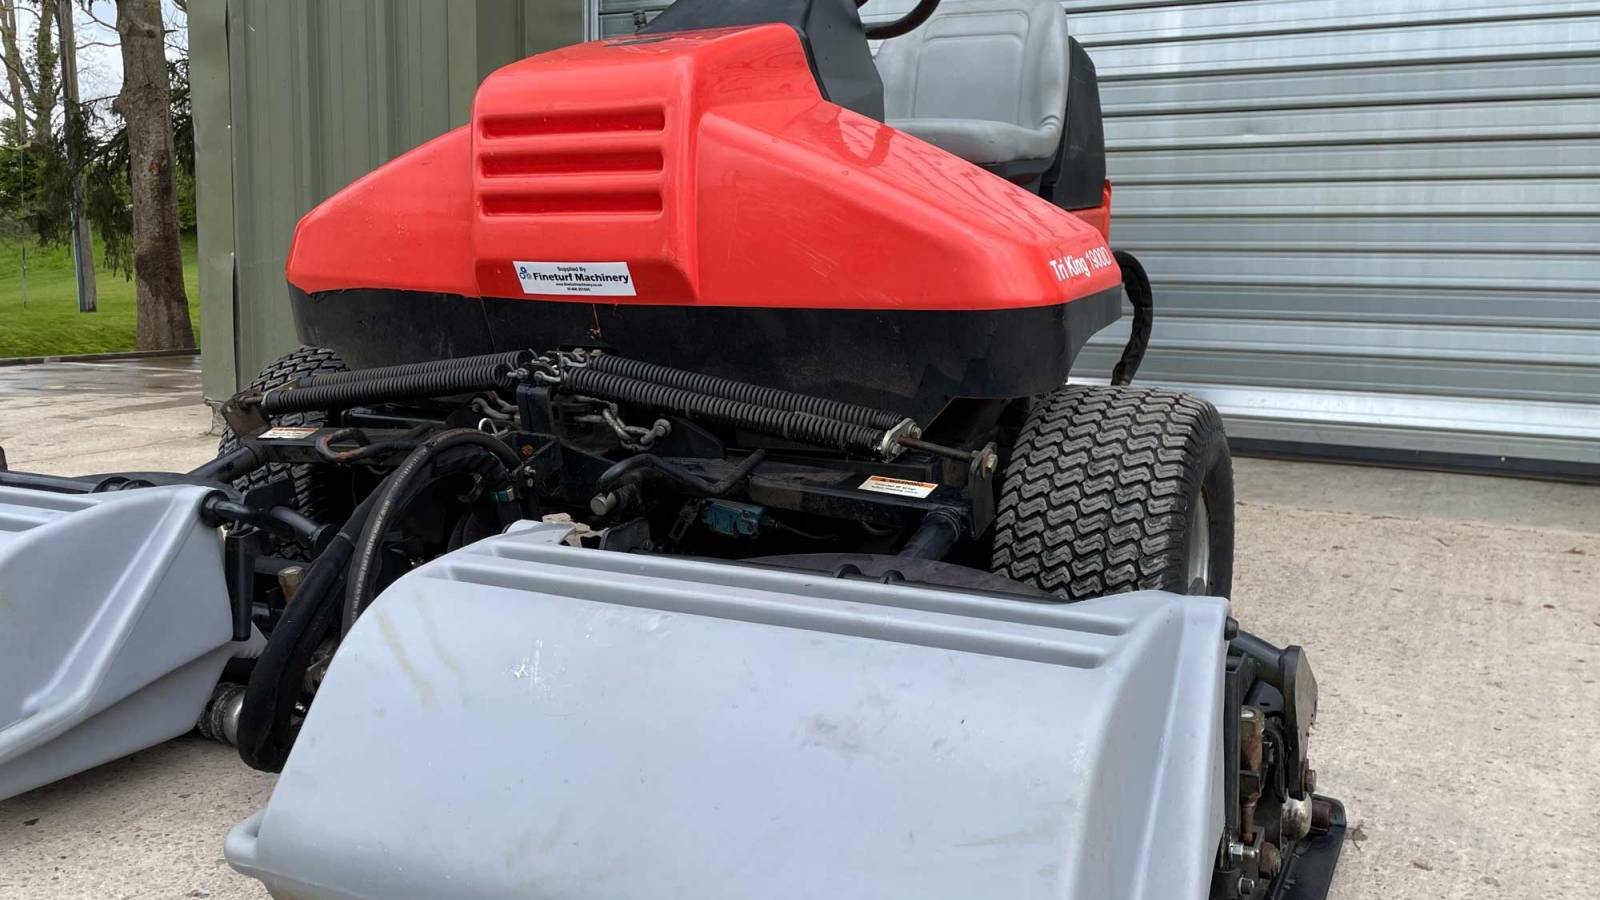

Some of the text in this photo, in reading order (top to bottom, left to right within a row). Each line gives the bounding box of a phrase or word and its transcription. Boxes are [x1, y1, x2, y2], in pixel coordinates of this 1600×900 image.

[1049, 258, 1069, 281] Tri
[1064, 255, 1091, 278] King
[533, 272, 629, 284] Fineturf Machinery
